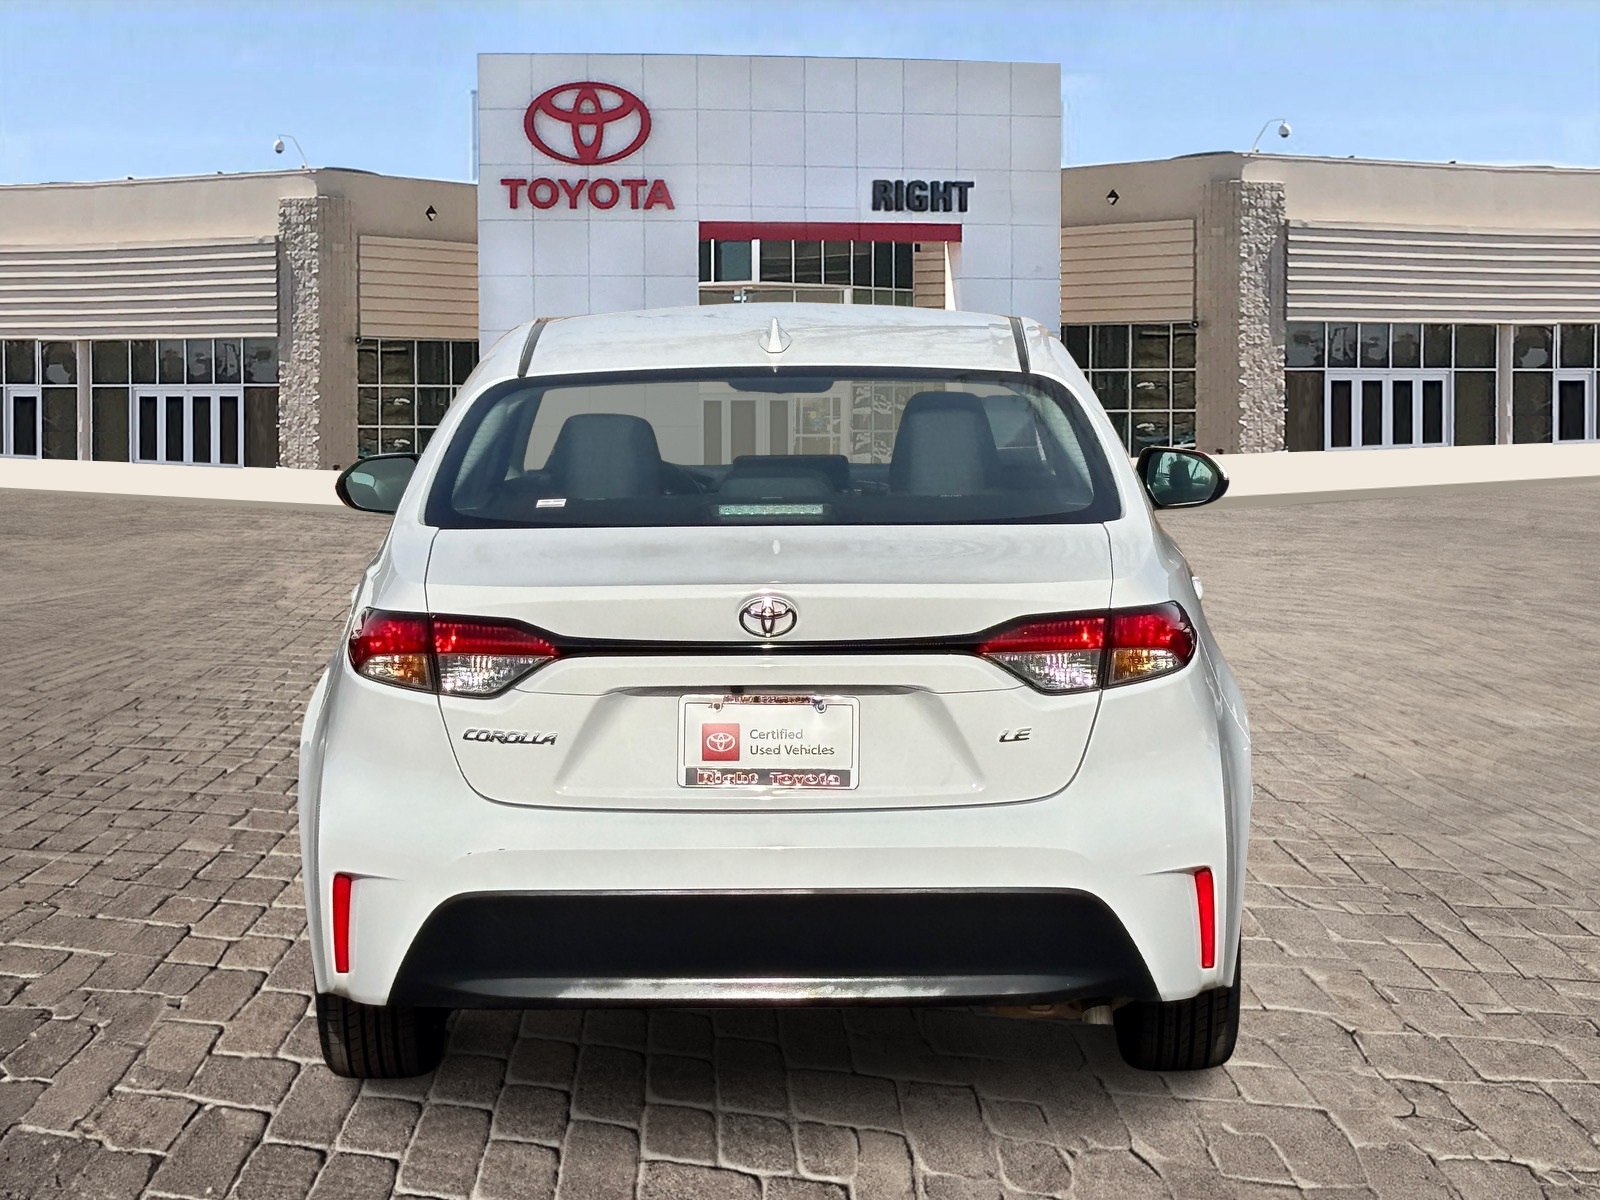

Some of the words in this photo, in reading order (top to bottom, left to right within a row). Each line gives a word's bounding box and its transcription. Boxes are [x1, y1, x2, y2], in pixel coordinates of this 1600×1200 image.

[500, 178, 675, 210] TOYOTA
[872, 180, 975, 213] RIGHT
[462, 728, 558, 745] COROLLA
[749, 728, 804, 740] Certified
[999, 727, 1032, 742] LE
[750, 744, 781, 755] Used
[785, 744, 835, 756] Vehicles
